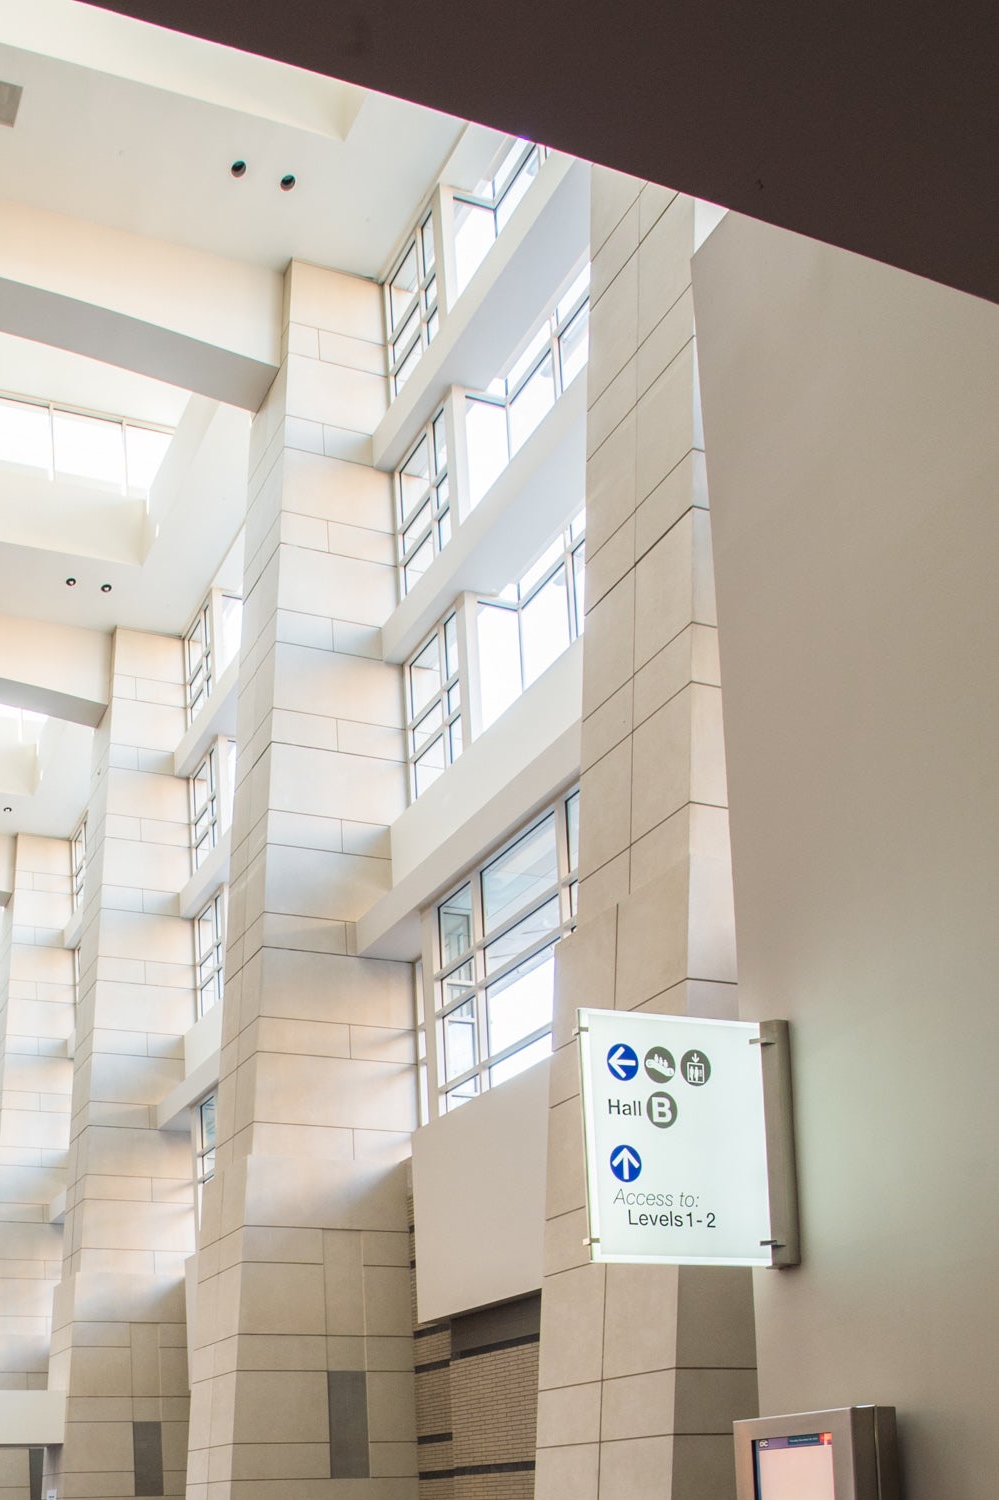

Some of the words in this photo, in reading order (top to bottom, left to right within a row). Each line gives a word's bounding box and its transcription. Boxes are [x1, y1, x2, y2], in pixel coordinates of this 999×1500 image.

[607, 1098, 642, 1117] Hall
[651, 1096, 672, 1123] B
[613, 1188, 674, 1207] Access
[679, 1191, 700, 1208] to:
[628, 1209, 684, 1227] Levels
